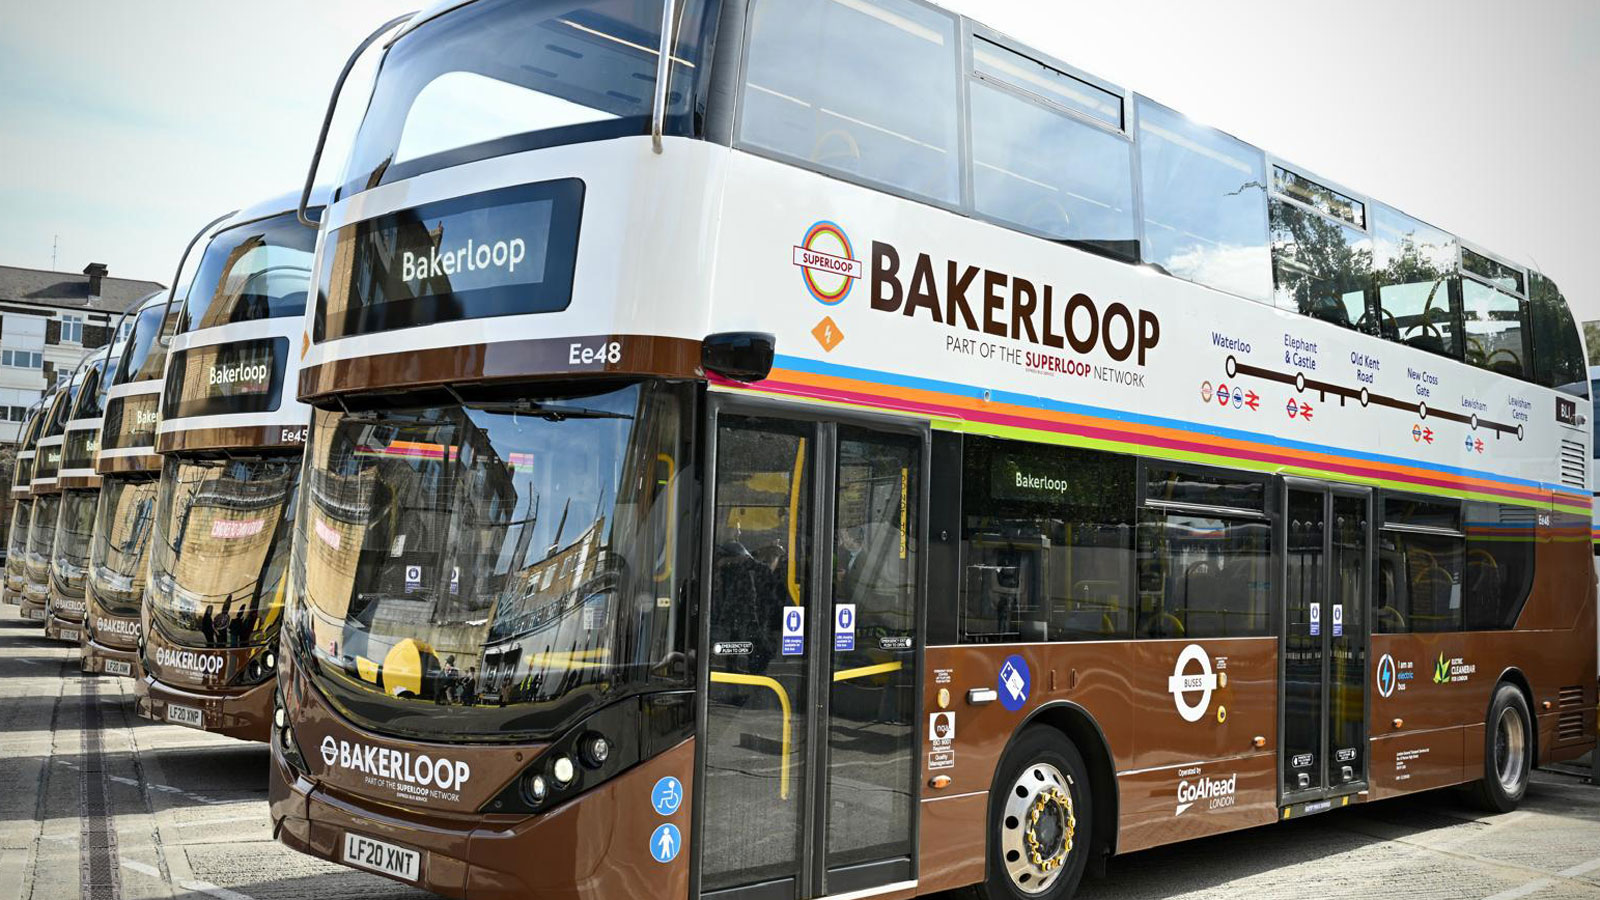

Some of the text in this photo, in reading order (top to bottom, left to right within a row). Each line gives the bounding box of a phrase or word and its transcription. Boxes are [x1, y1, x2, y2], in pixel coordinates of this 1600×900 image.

[402, 236, 526, 282] Bakerloop
[802, 252, 854, 274] SUPERLOOP
[870, 240, 1160, 366] BAKERLOOP
[569, 342, 622, 364] Ee48
[1212, 332, 1251, 354] Waterloo
[1284, 334, 1318, 354] Elephant
[946, 335, 1144, 388] PART OF THE SUPERLOOP NETWORK
[1285, 350, 1316, 370] & Castle
[1350, 352, 1380, 370] Old Kent
[209, 363, 267, 386] Bakerloop
[1357, 369, 1373, 384] Road
[1408, 368, 1438, 386] New Cross
[1416, 384, 1430, 398] Gate
[1462, 395, 1488, 412] Lewisham
[1508, 394, 1532, 410] Lewisham
[1512, 408, 1528, 422] Centre
[282, 428, 308, 442] Ee45
[1016, 472, 1068, 494] Bakerloop
[164, 650, 224, 674] BAKERLOOP
[1184, 678, 1202, 688] BUSES
[170, 704, 199, 724] LF20 XNP
[340, 740, 470, 791] BAKERLOOP
[365, 776, 460, 802] PART OF THE SUPERLOOP NETWORK
[1178, 772, 1236, 803] GoAhead
[1210, 796, 1234, 809] LONDON
[350, 837, 413, 875] LF20 XNT
